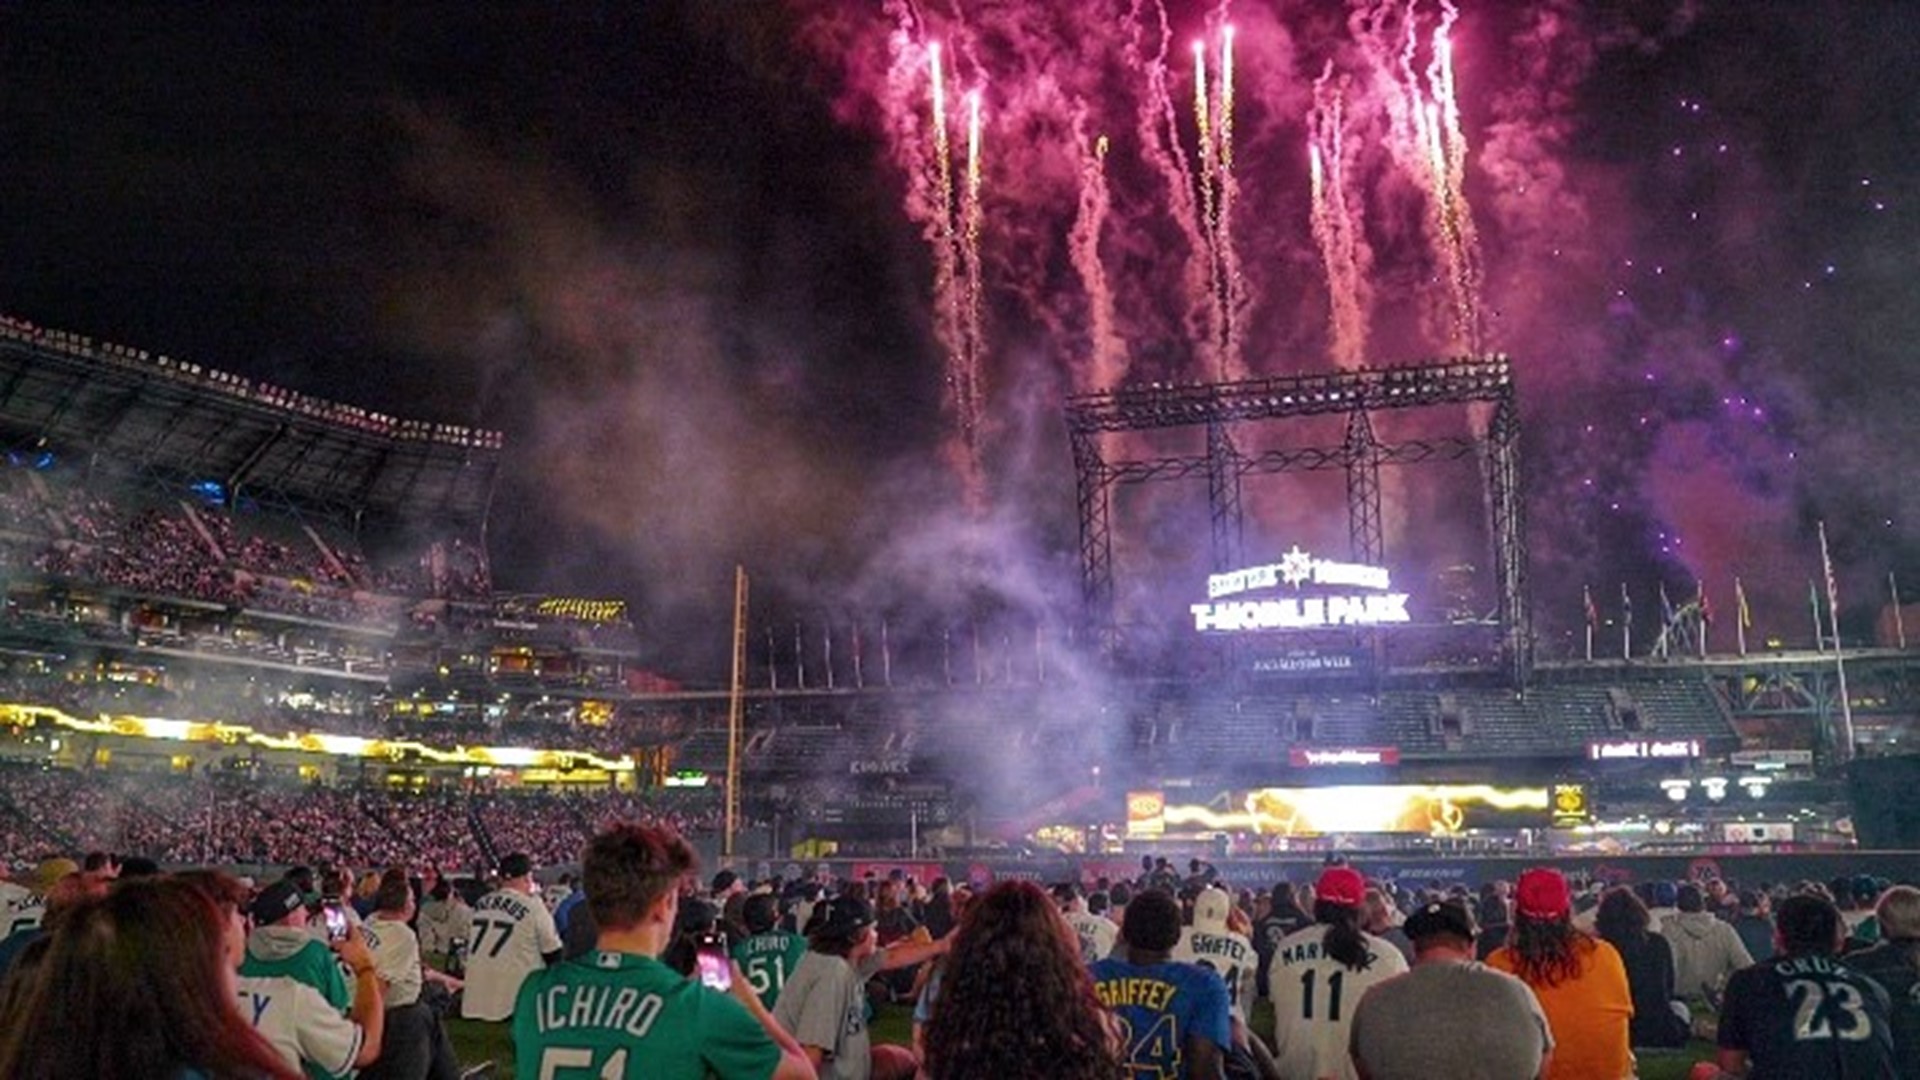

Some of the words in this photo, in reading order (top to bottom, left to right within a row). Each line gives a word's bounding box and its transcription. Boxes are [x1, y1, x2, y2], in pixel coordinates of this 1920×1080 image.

[1328, 593, 1411, 625] PARK
[472, 918, 514, 957] 77
[748, 954, 786, 993] 51
[1775, 954, 1849, 979] CRUZ
[536, 985, 663, 1037] ICHIRO
[1094, 977, 1177, 1011] GRIFFEY
[1302, 969, 1343, 1021] 11
[1785, 979, 1872, 1041] 23
